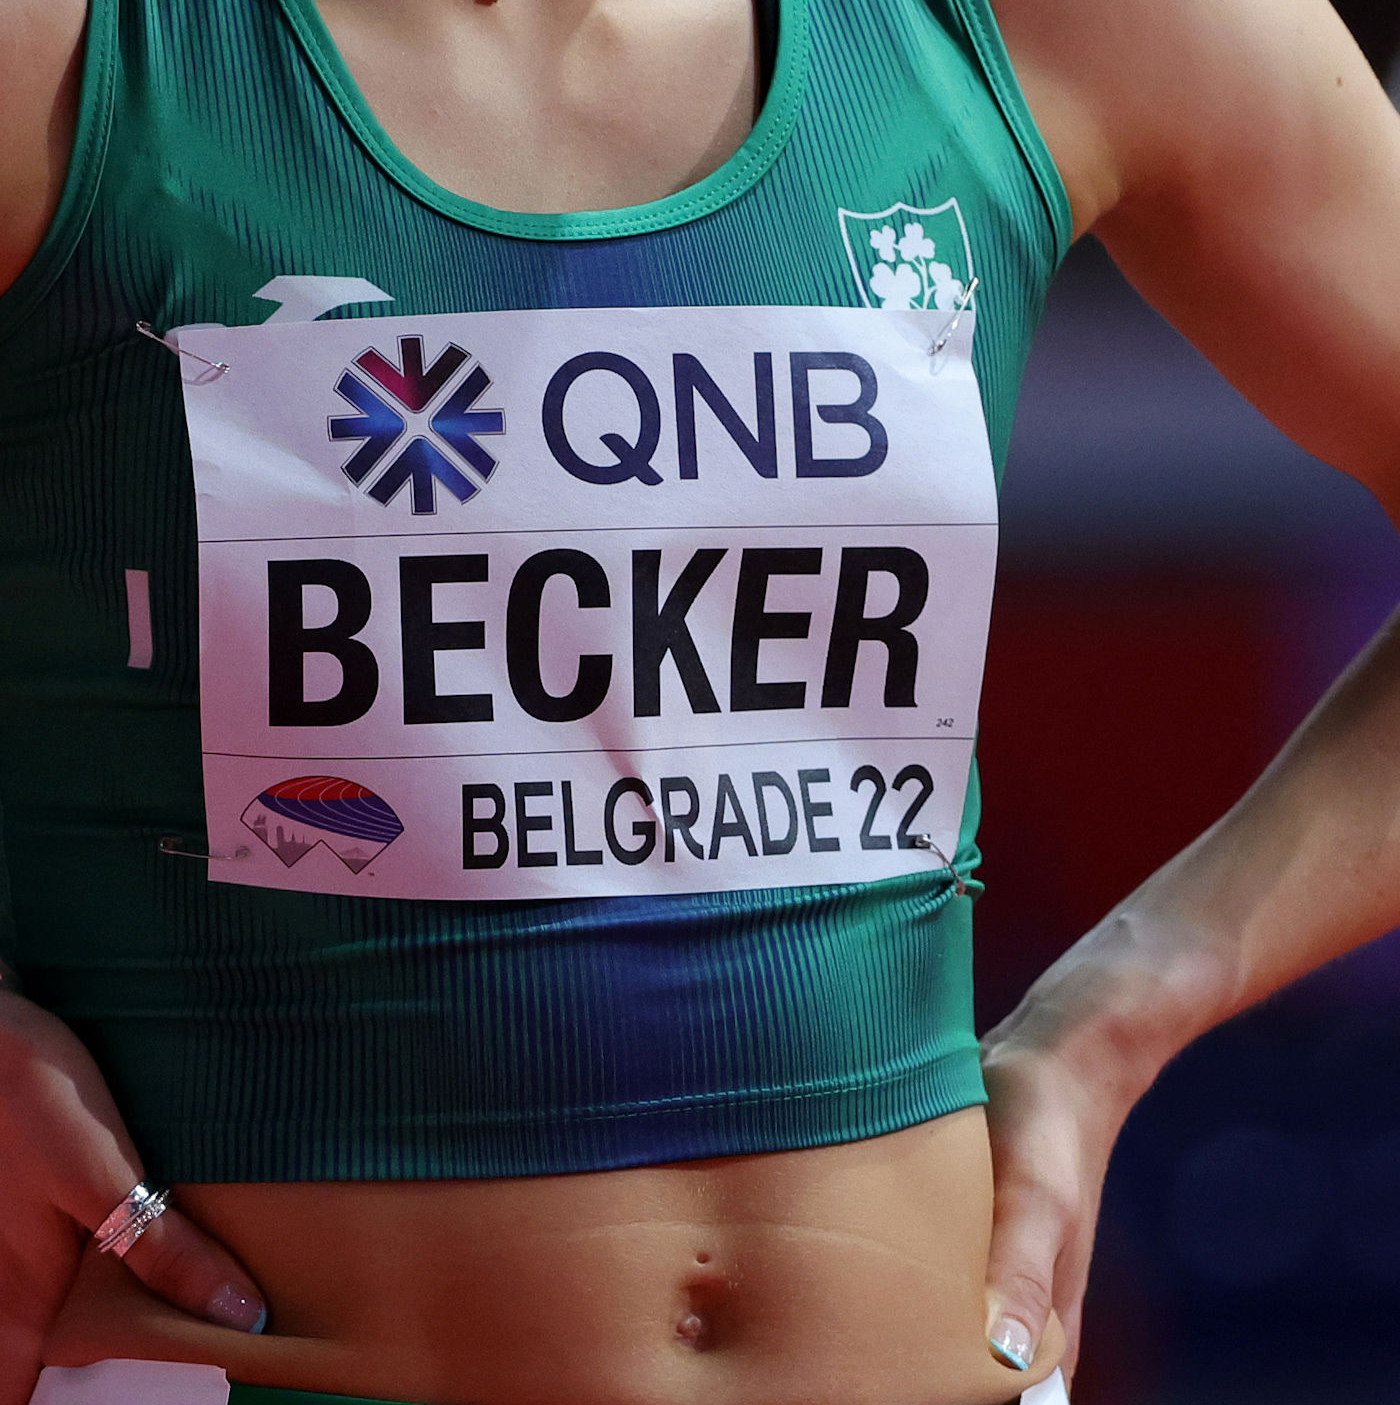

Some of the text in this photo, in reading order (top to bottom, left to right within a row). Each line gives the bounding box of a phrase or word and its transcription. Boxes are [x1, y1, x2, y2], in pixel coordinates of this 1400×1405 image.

[541, 350, 890, 487] QNB
[266, 546, 930, 728] BECKER
[935, 717, 955, 728] 242
[460, 763, 934, 871] BELGRADE 22
